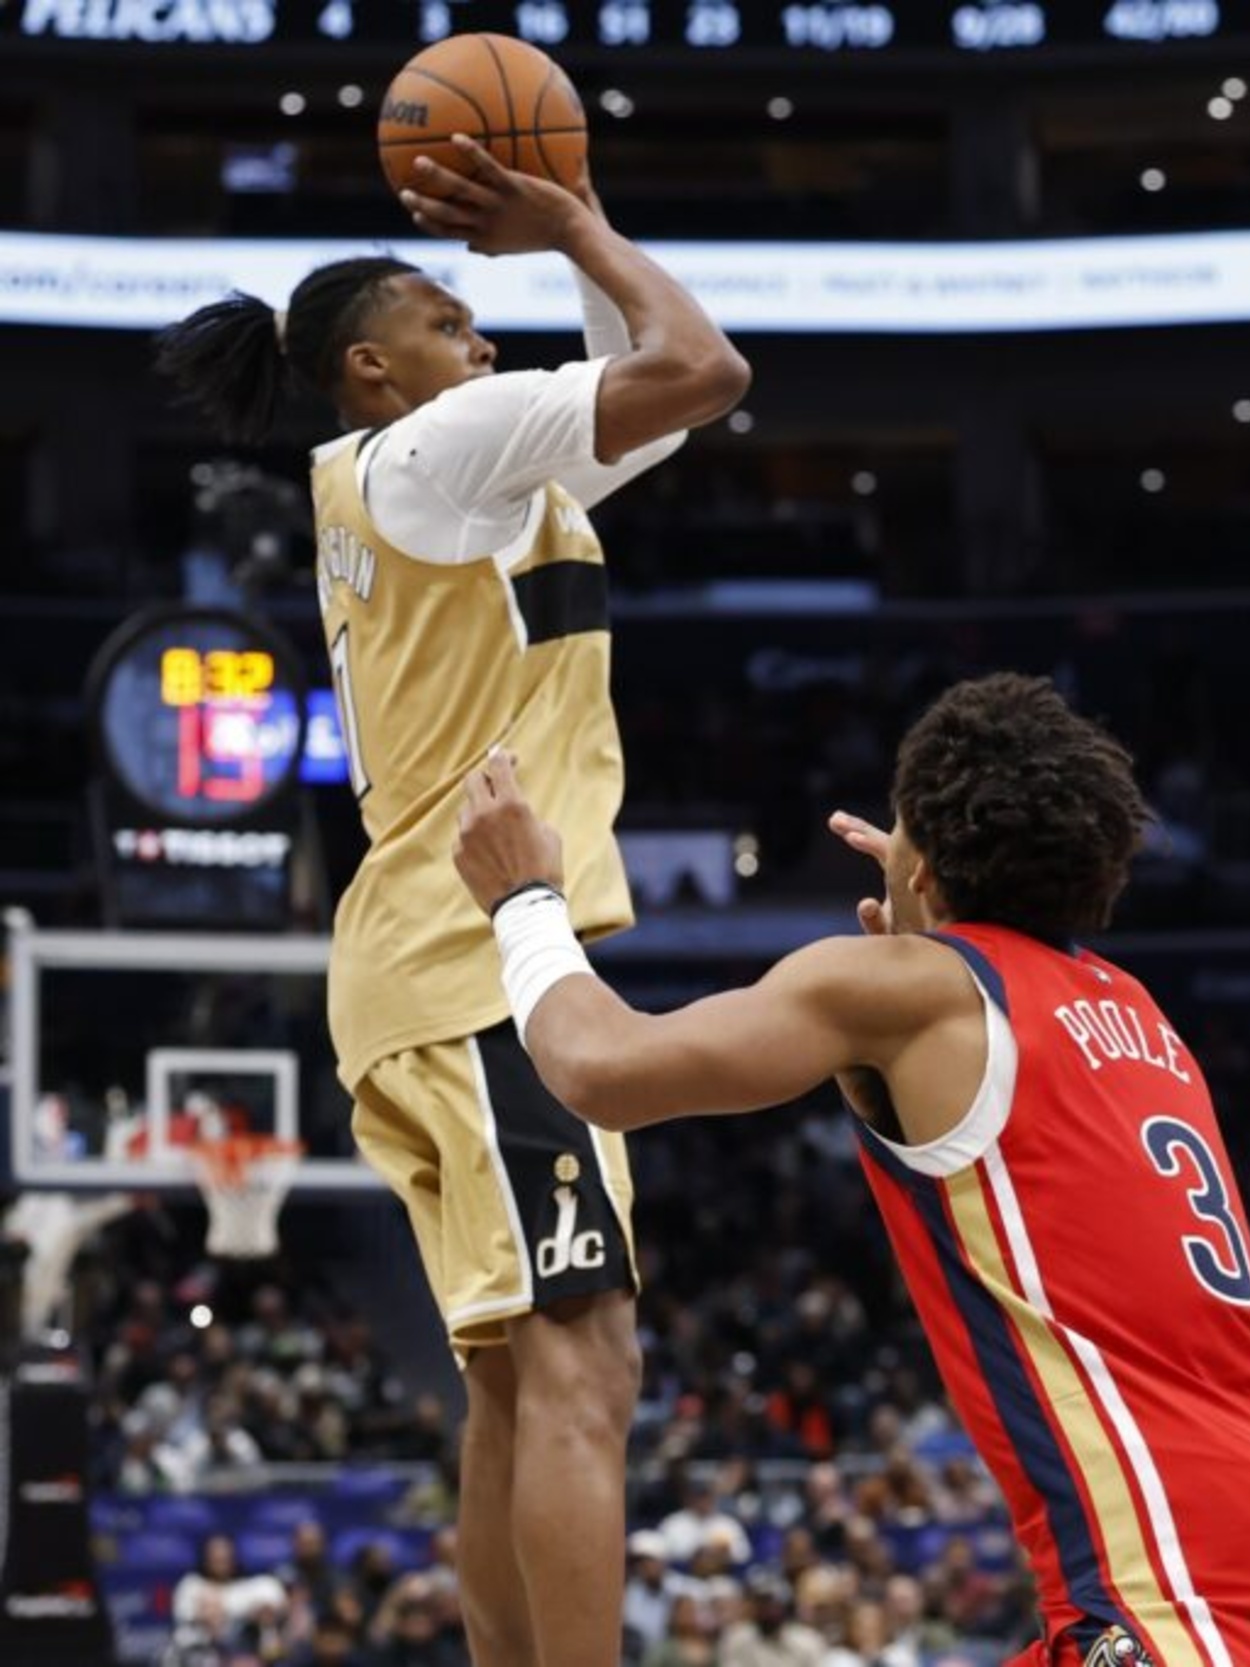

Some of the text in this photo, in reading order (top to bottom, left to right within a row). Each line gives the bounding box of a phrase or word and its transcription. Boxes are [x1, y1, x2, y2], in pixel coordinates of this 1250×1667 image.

[22, 0, 276, 43] PELICANS
[162, 829, 290, 868] TISSOT
[1054, 999, 1191, 1084] POOLE
